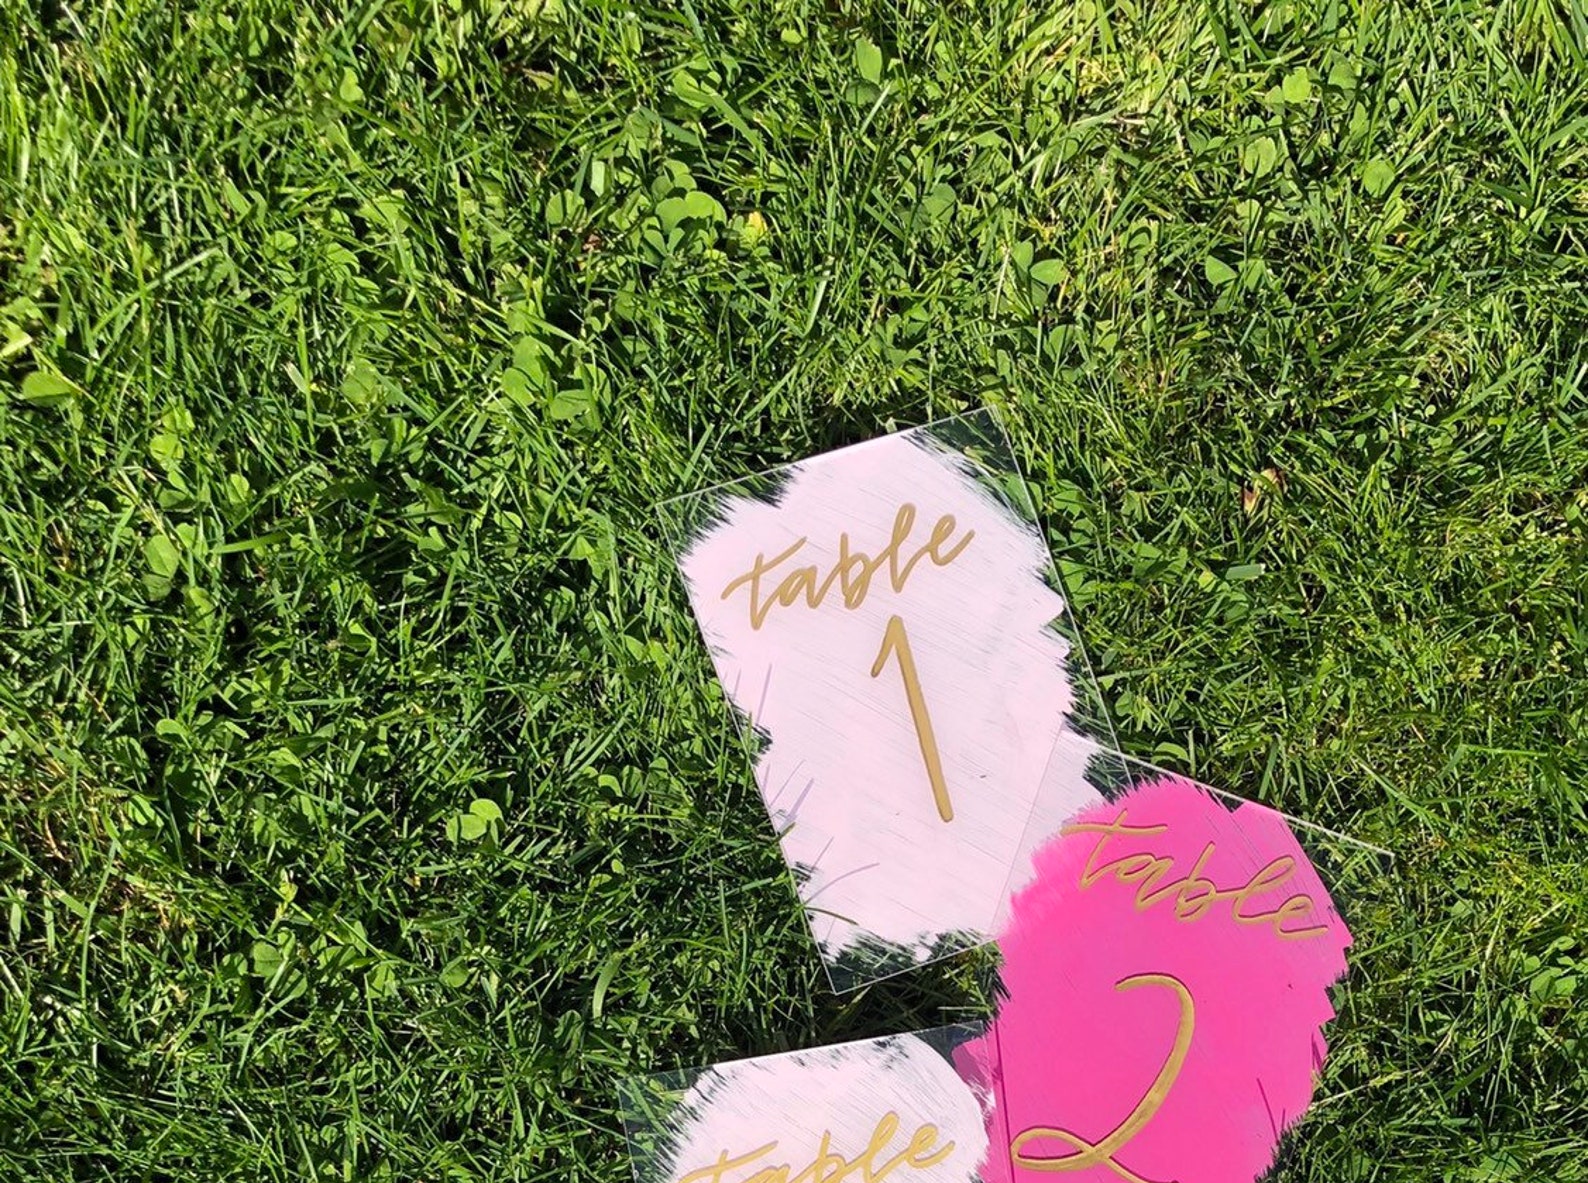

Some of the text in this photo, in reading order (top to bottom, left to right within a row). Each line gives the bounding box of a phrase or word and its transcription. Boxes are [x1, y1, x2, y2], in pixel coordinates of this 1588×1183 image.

[721, 503, 976, 631] table
[871, 615, 952, 823] 1
[1060, 810, 1328, 938] table
